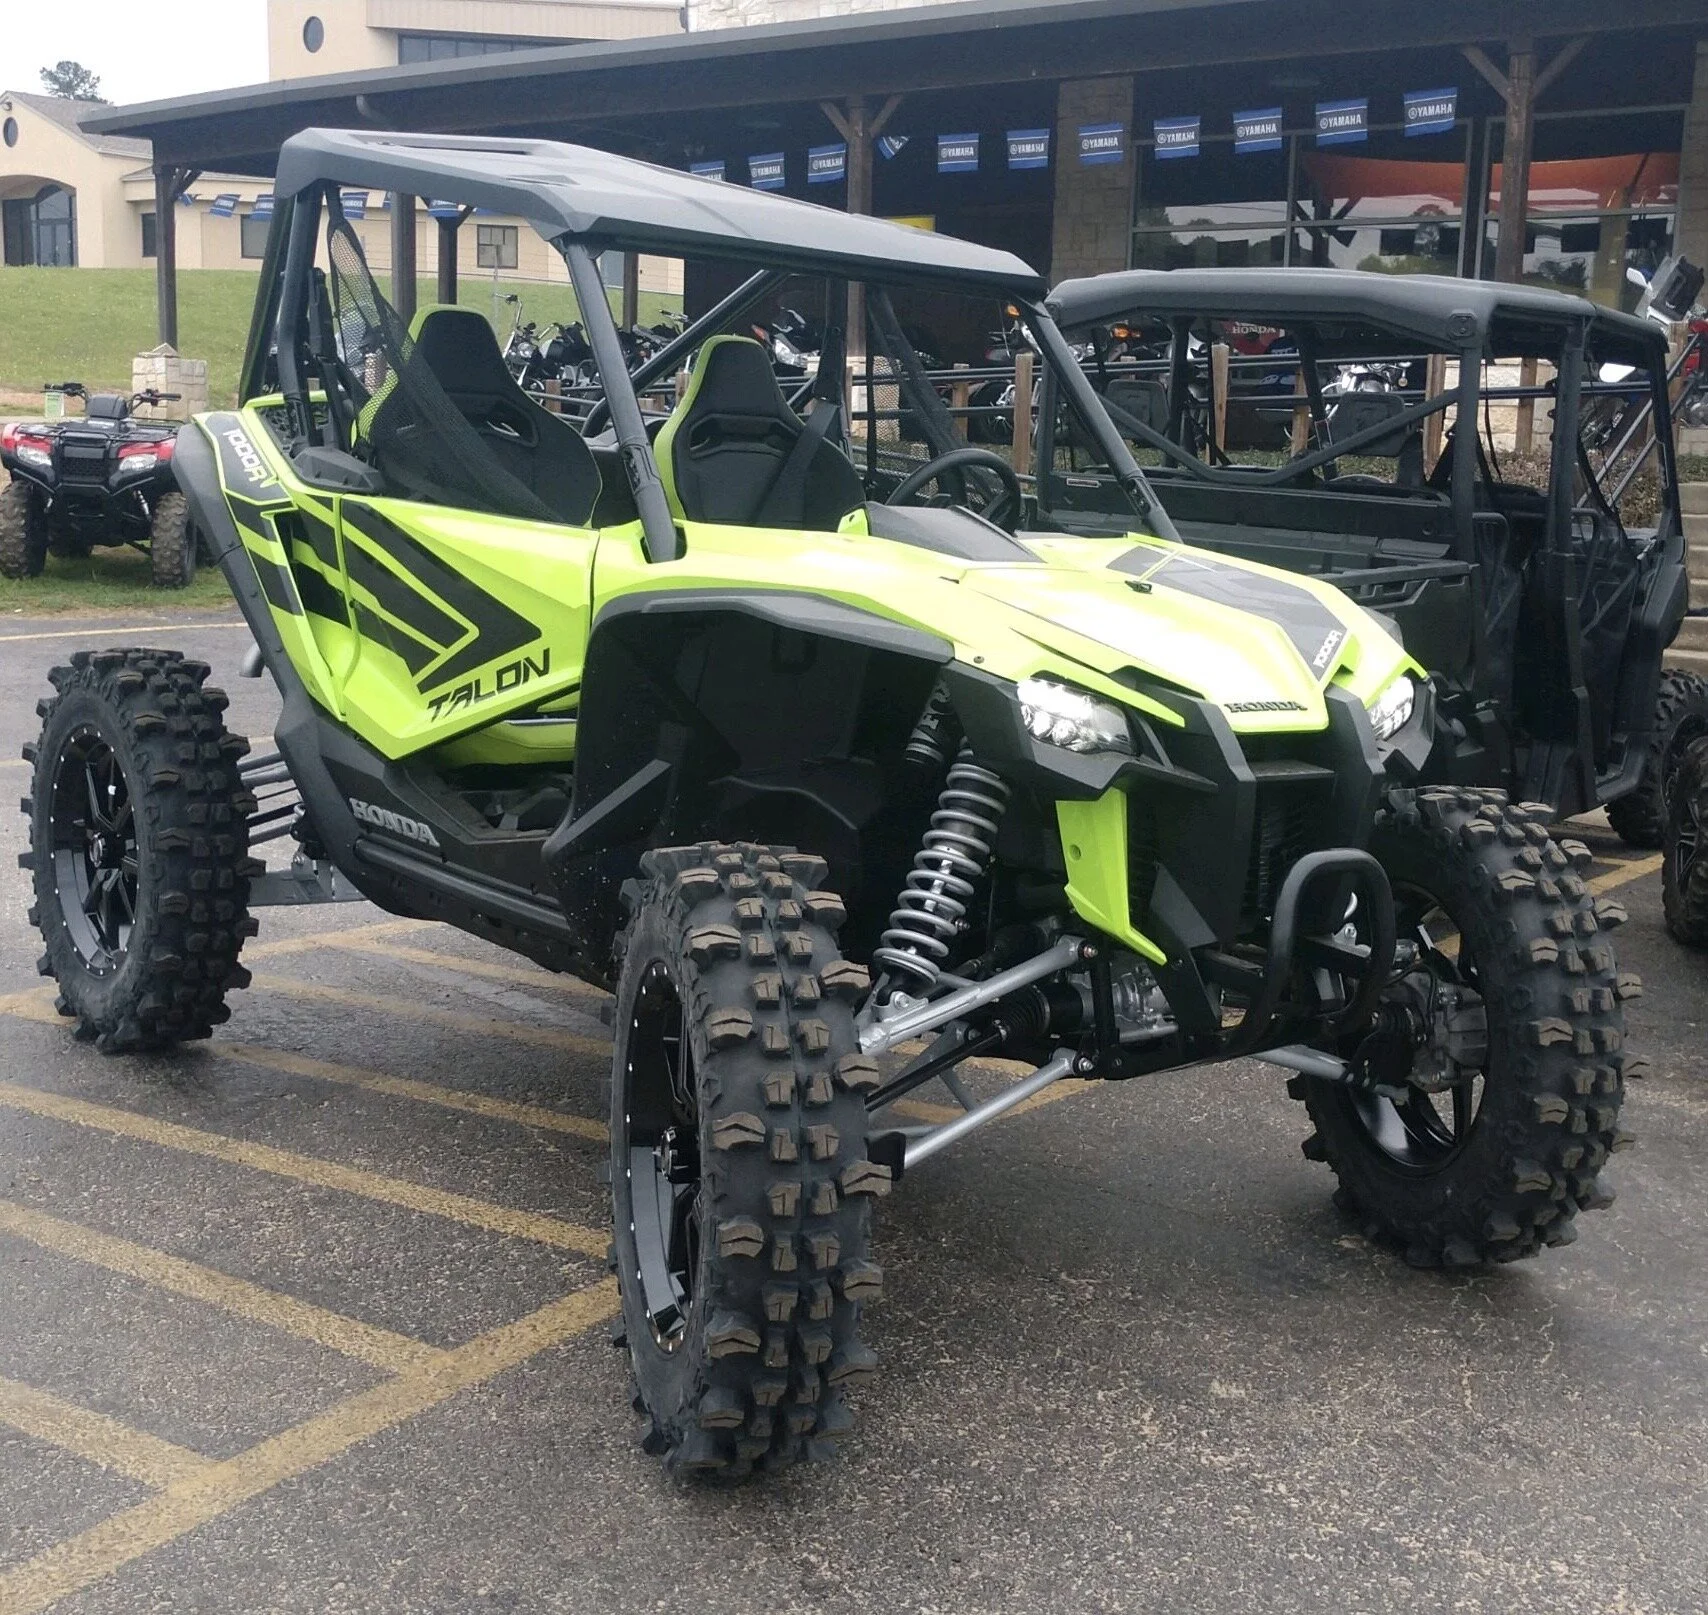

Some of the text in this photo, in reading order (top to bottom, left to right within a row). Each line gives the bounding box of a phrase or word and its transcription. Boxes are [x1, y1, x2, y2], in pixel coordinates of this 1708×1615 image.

[1418, 103, 1453, 116] YAMAHA
[1328, 114, 1362, 127] YAMAHA
[1245, 123, 1277, 135] YAMAHA
[1018, 143, 1045, 154] YAMAHA
[1089, 137, 1119, 148] YAMAHA
[947, 146, 974, 157] YAMAHA
[819, 157, 842, 168] YAMAHA
[757, 165, 781, 175] YAMAHA
[1233, 326, 1276, 334] HONDA
[223, 429, 267, 482] 1000R
[427, 648, 550, 723] TALON
[1224, 701, 1308, 714] HONDA
[349, 797, 440, 848] HONDA
